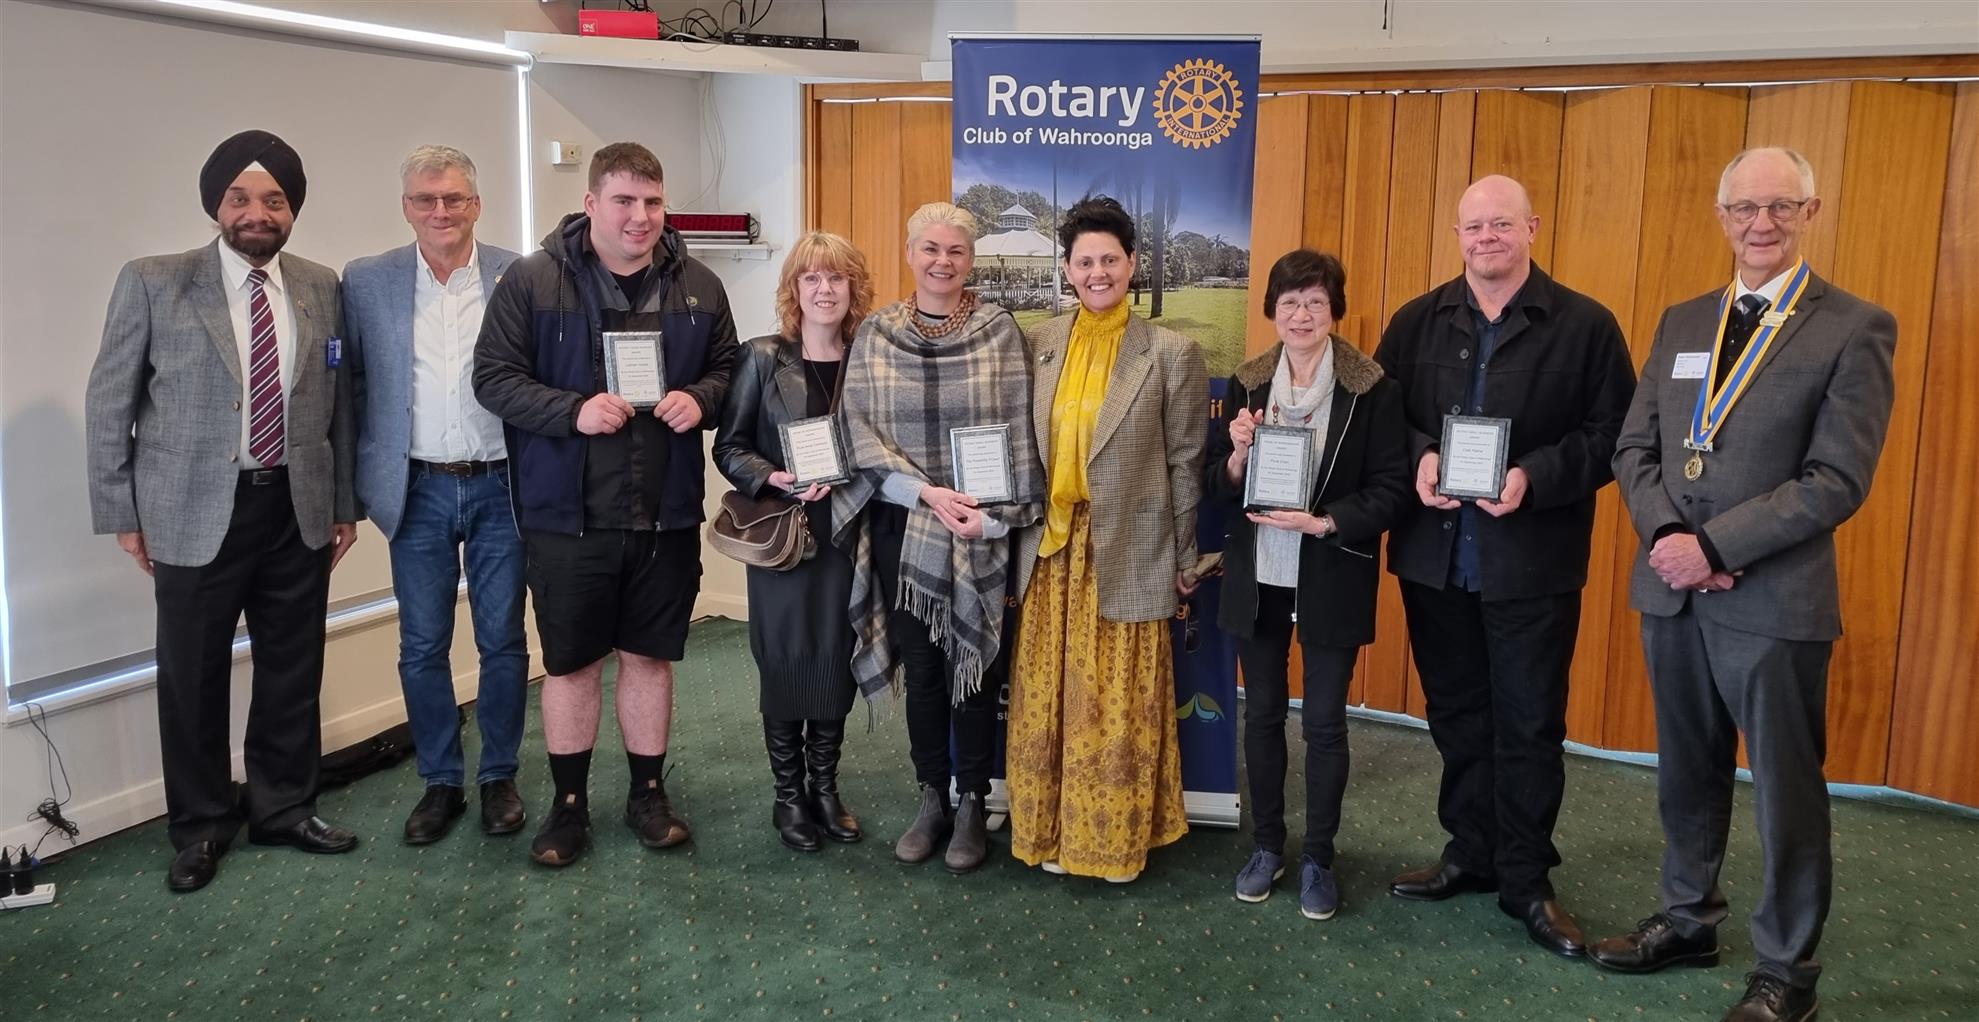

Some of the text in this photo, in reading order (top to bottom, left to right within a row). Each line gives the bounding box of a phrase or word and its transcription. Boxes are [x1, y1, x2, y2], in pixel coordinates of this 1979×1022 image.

[1180, 69, 1218, 80] ROTARY
[987, 74, 1145, 127] Rotary
[963, 127, 1152, 149] Club of Wahroonga
[1167, 117, 1230, 139] INTERNATIONAL
